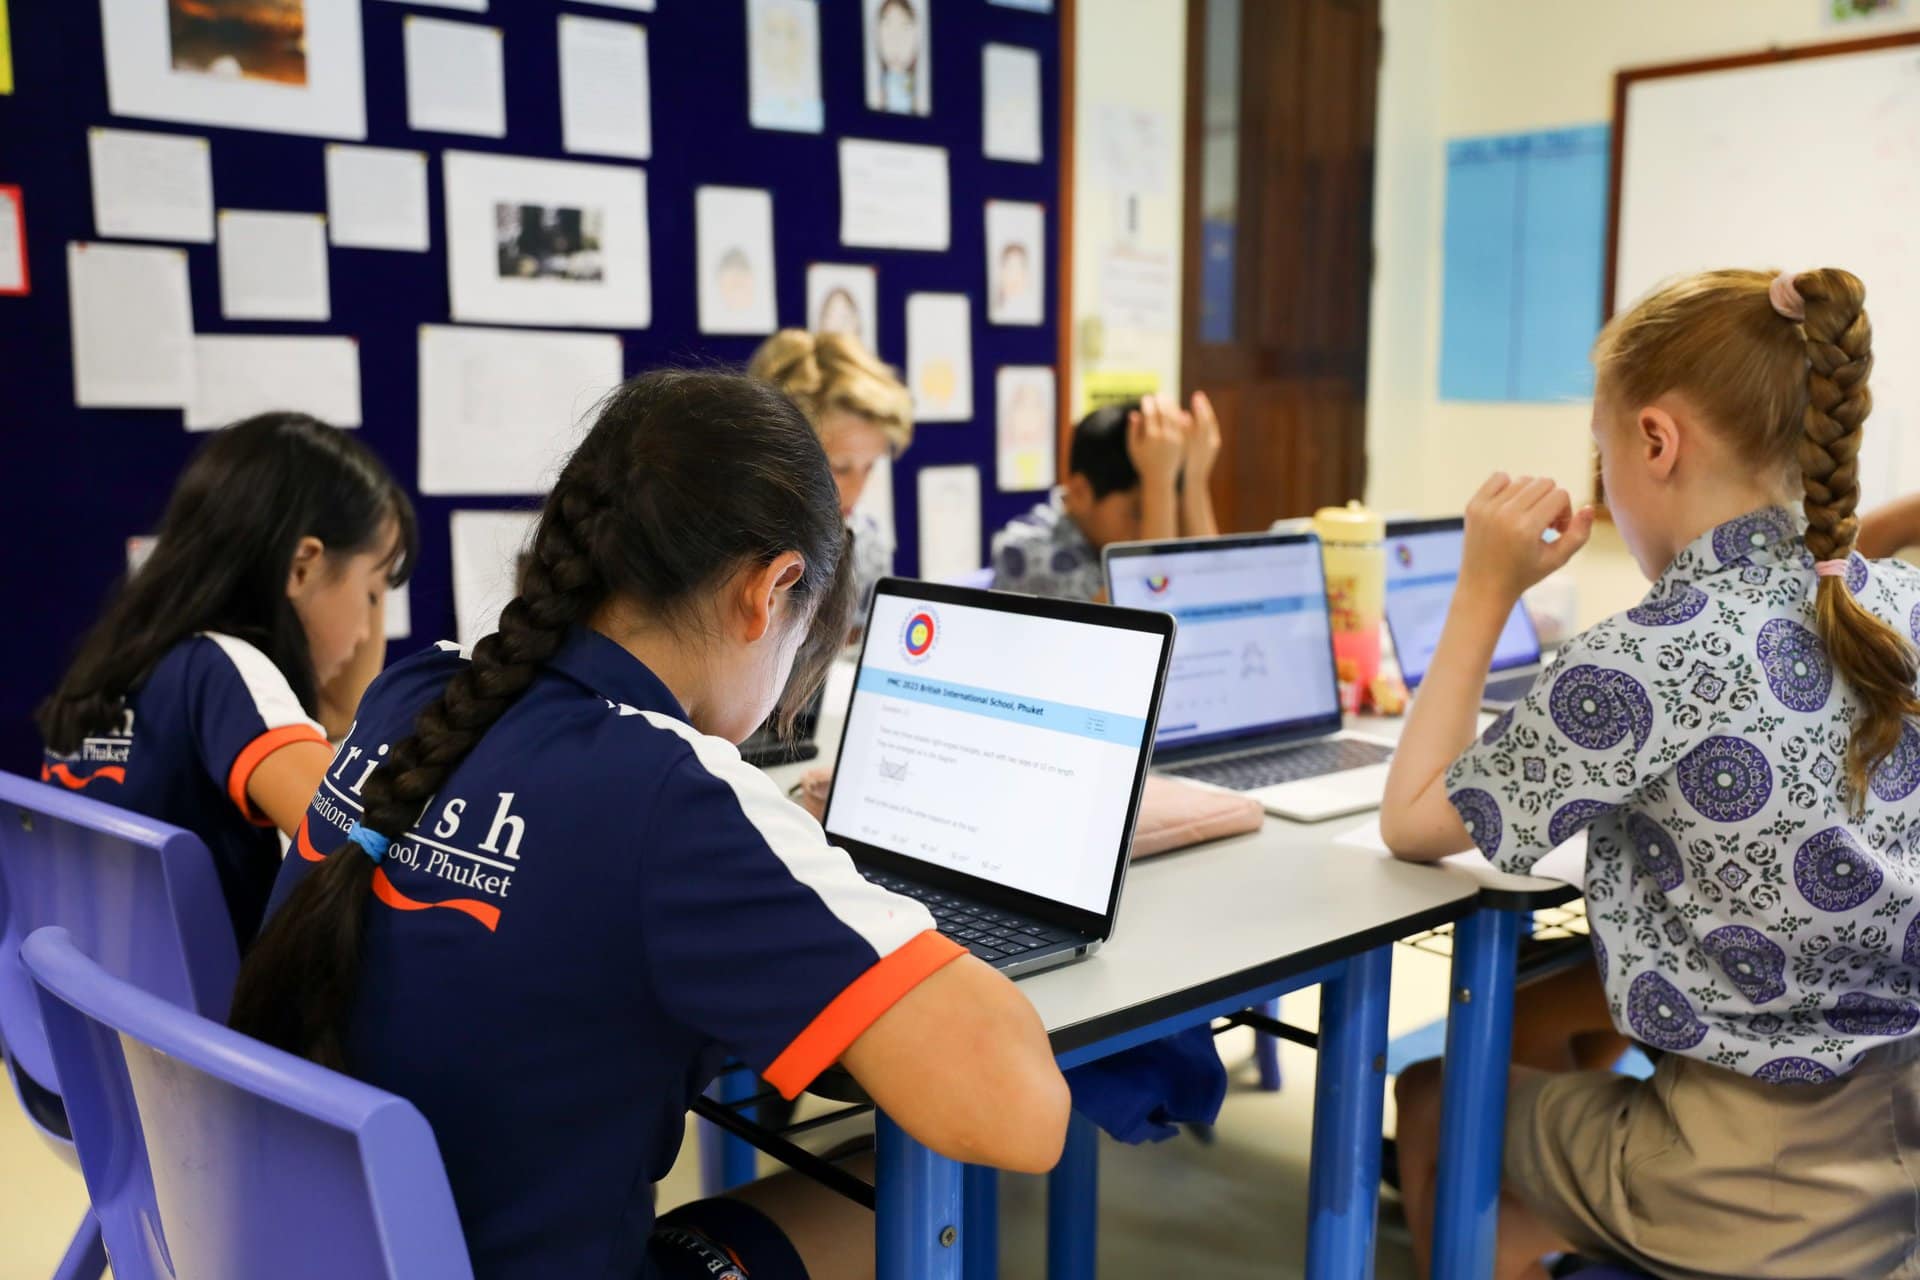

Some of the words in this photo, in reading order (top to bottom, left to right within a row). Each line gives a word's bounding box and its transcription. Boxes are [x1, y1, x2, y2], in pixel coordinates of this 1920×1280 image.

[919, 684, 941, 695] British
[943, 687, 988, 705] International
[989, 696, 1015, 711] School,
[1017, 702, 1044, 716] Phuket
[311, 789, 355, 834] nationa
[388, 841, 421, 872] ool,
[424, 849, 511, 897] Phuket
